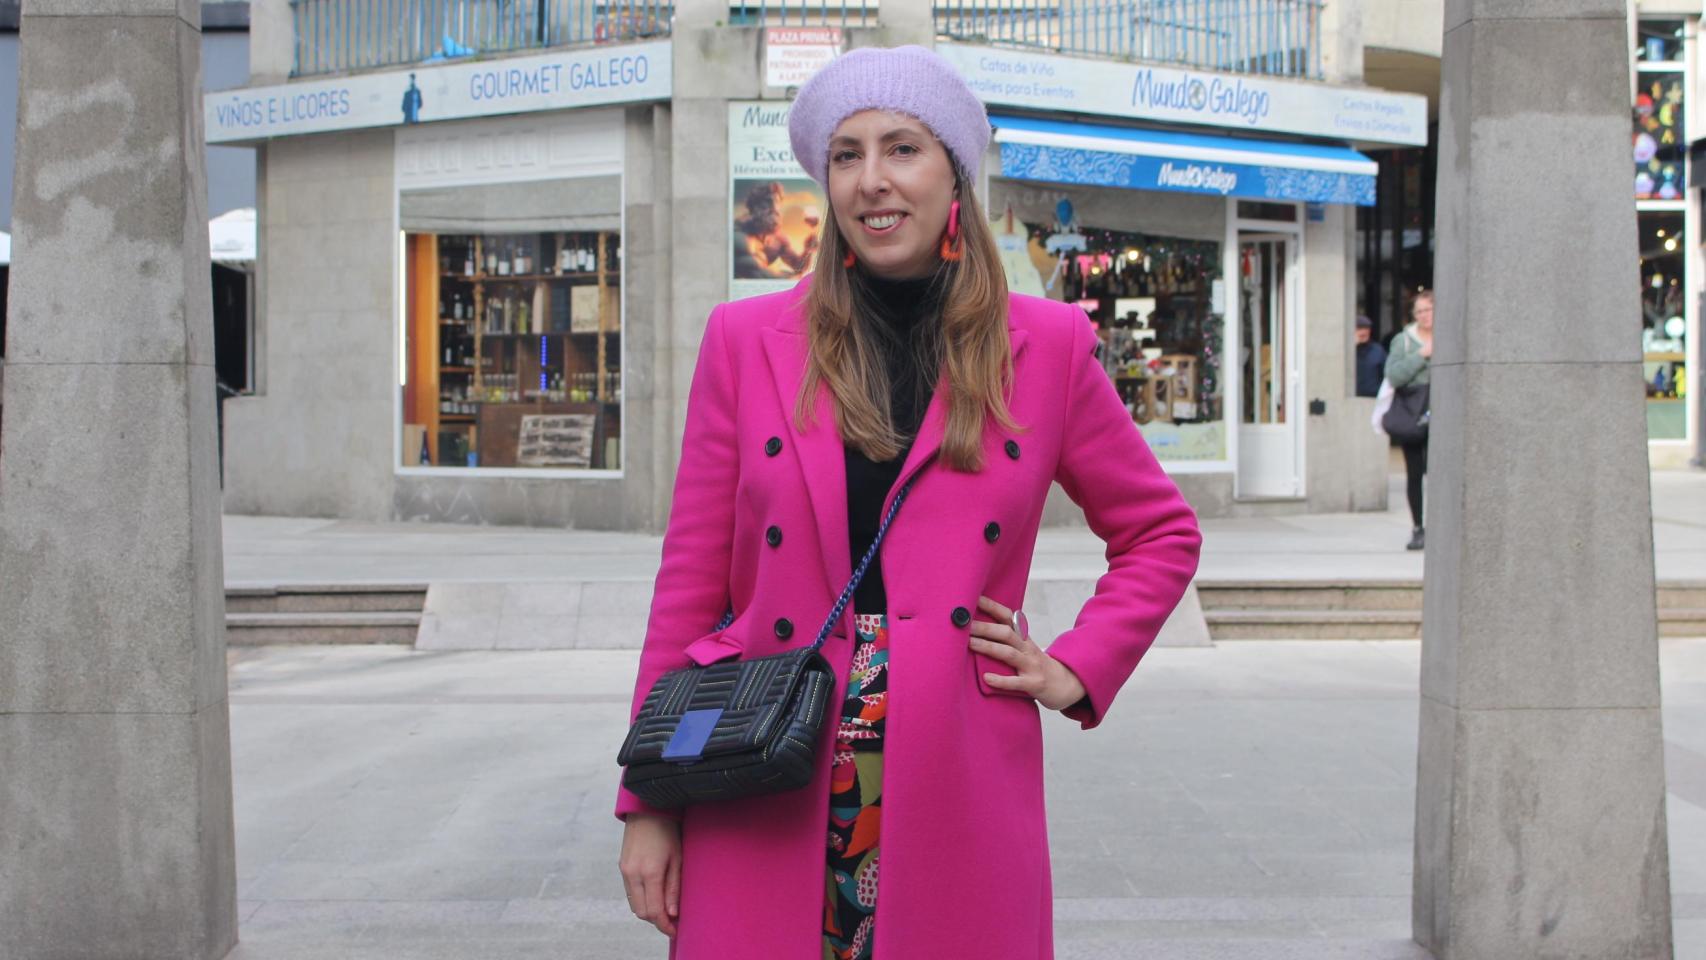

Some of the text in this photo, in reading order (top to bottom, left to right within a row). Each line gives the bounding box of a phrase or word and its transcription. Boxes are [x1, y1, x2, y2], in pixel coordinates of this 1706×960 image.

[470, 55, 648, 101] GOURMET GALEGO
[980, 57, 1012, 72] Catas
[1014, 62, 1028, 74] de
[216, 89, 350, 128] VIÑOS E LICORES
[967, 79, 1075, 99] etalles para Eventos
[1209, 77, 1269, 125] Galego
